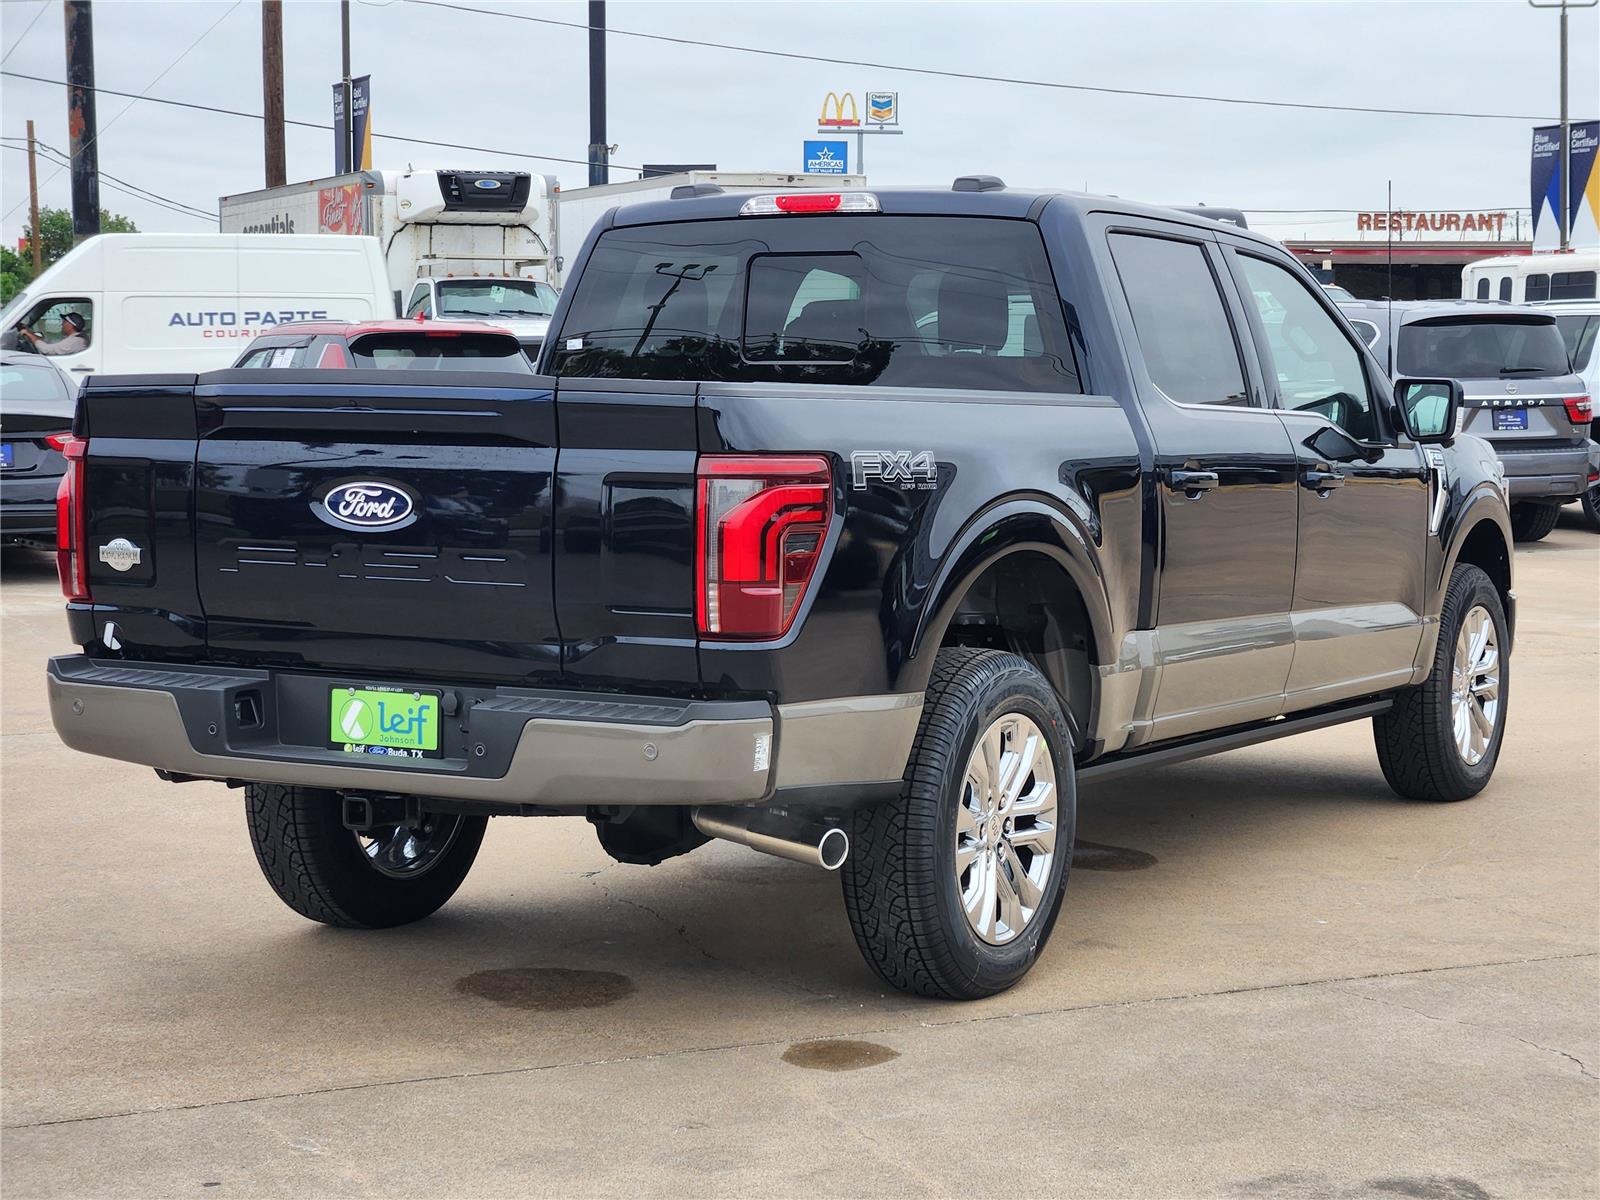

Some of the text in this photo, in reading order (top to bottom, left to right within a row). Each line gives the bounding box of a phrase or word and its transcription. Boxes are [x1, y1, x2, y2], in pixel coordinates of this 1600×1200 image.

[1534, 134, 1549, 144] Blue
[1571, 128, 1586, 139] Gold
[1534, 142, 1560, 152] Certified
[1571, 136, 1598, 148] Certified
[1357, 213, 1507, 232] RESTAURANT
[168, 312, 236, 326] AUTO
[850, 450, 938, 490] FX4
[338, 486, 395, 518] Ford
[380, 734, 415, 744] Johnson
[411, 750, 424, 758] TX
